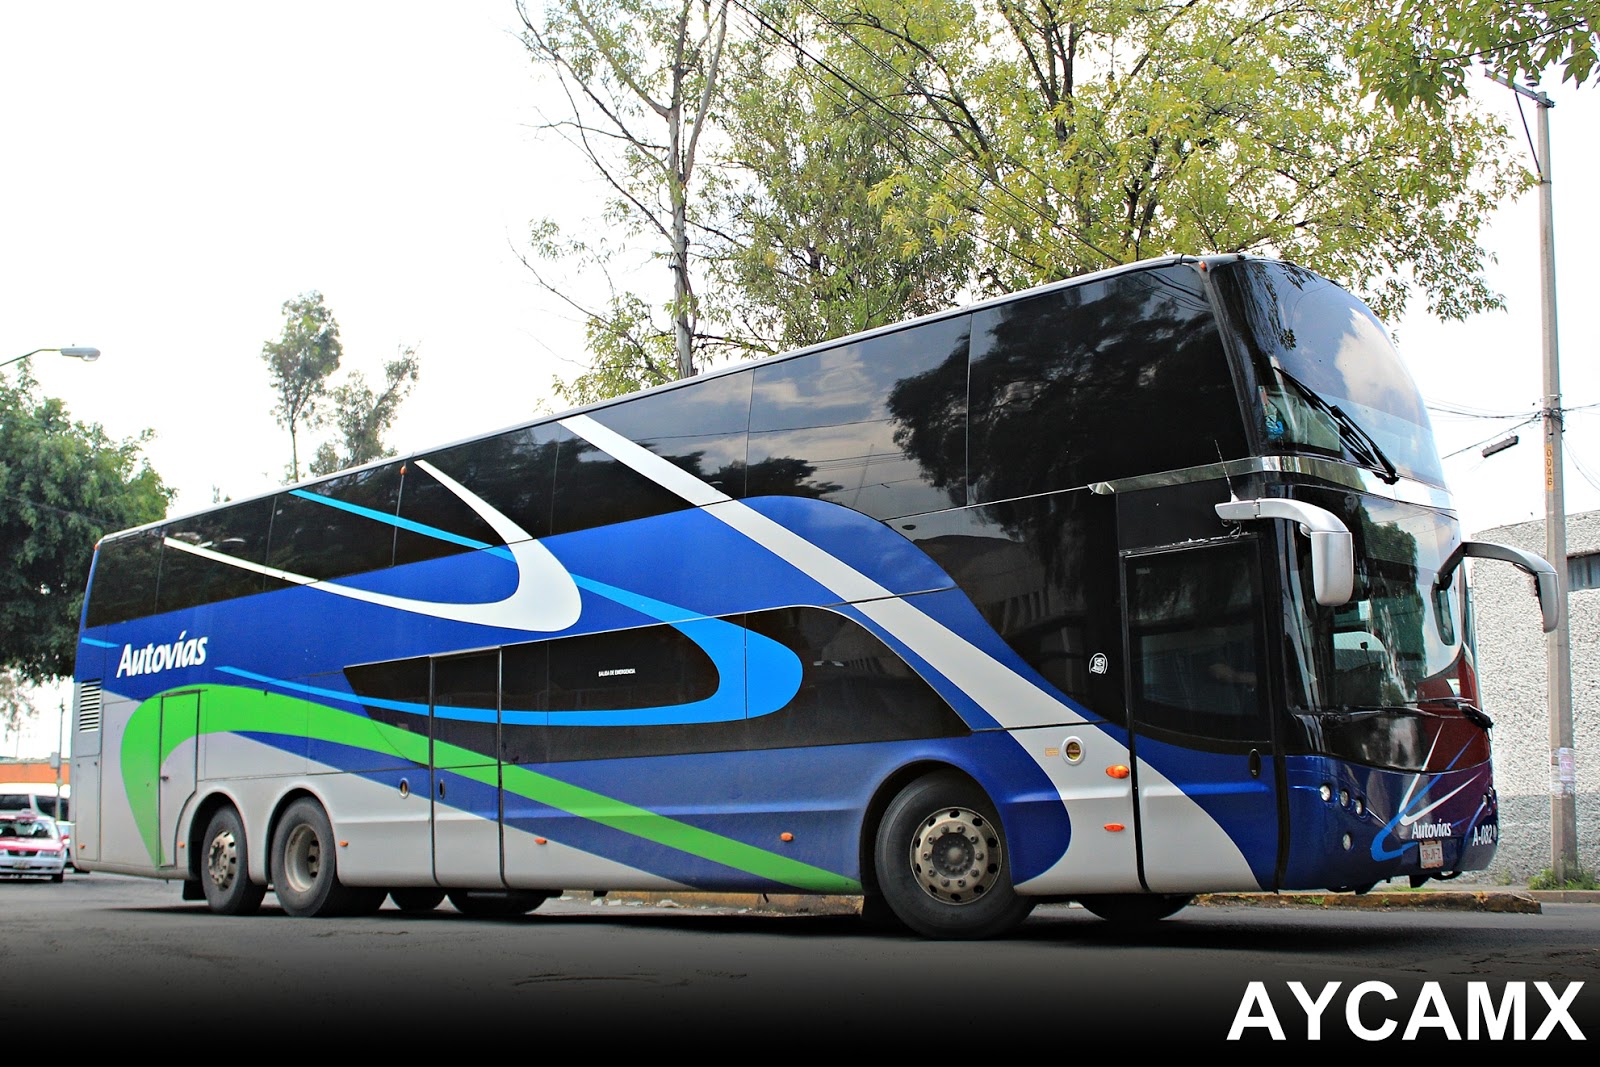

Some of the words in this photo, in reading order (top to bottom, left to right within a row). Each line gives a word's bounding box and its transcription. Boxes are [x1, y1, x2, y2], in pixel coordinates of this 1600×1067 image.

[116, 630, 208, 678] Autovías
[1412, 818, 1452, 839] Autovías
[1472, 825, 1493, 846] A-082
